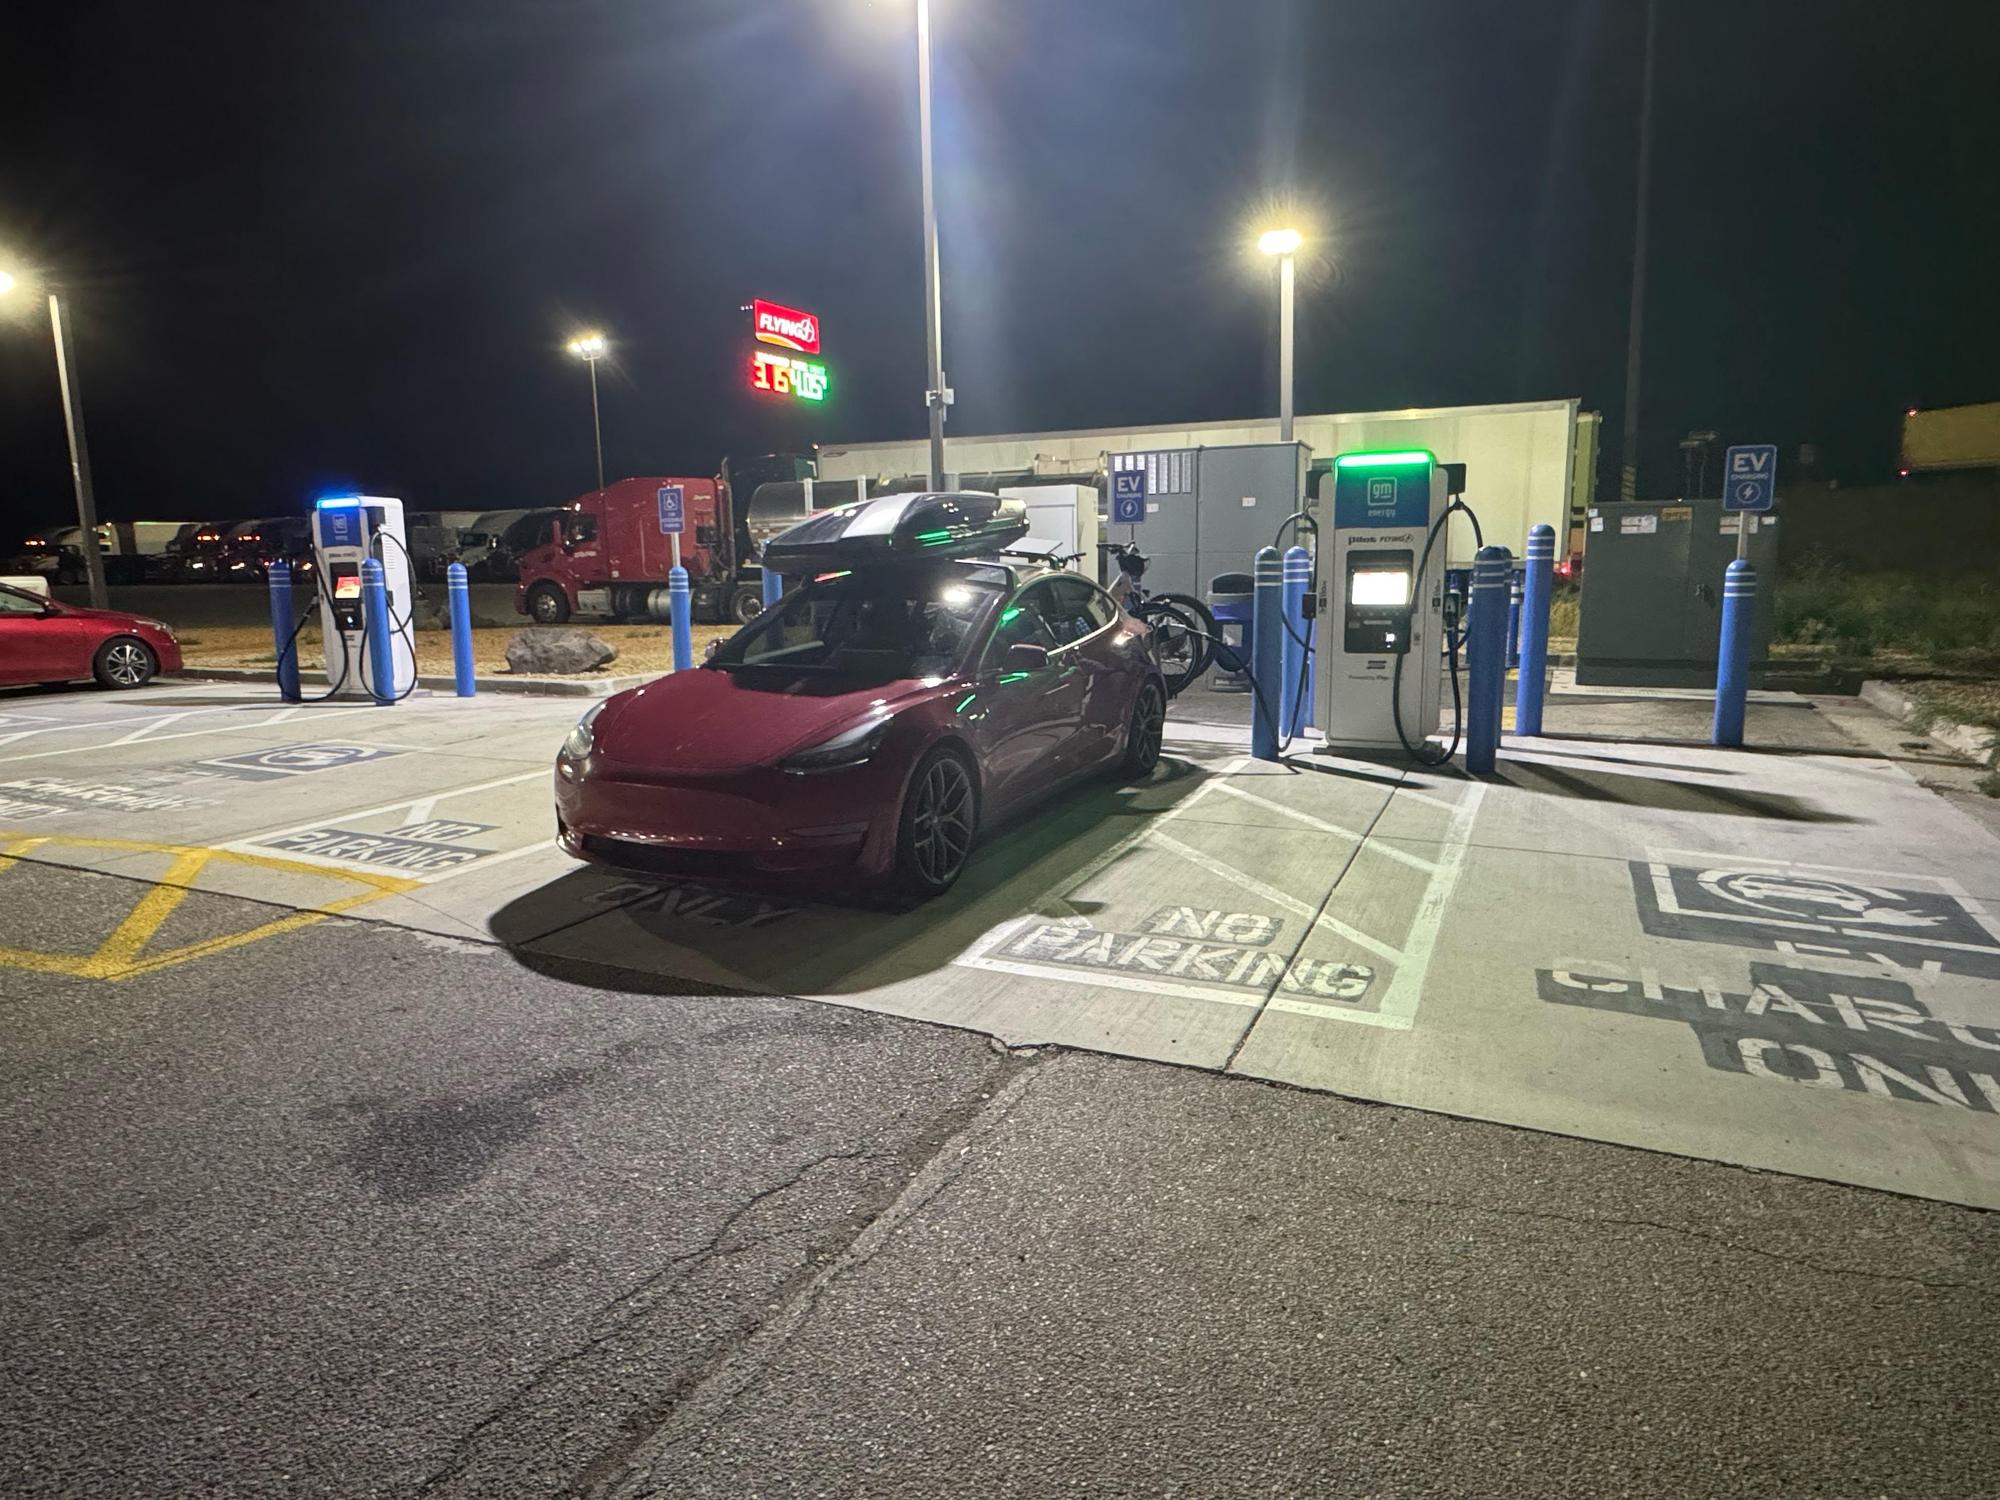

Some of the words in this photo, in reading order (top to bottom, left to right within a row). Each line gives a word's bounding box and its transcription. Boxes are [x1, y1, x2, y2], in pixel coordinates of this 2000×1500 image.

[1734, 452, 1769, 472] EV
[1117, 476, 1140, 492] EV
[1373, 483, 1392, 499] gm
[1368, 508, 1396, 518] energy
[389, 821, 481, 841] NO
[264, 831, 477, 870] PARKING
[1150, 907, 1270, 943] NO
[1011, 925, 1374, 999] PARKING
[1773, 940, 1943, 985] EV
